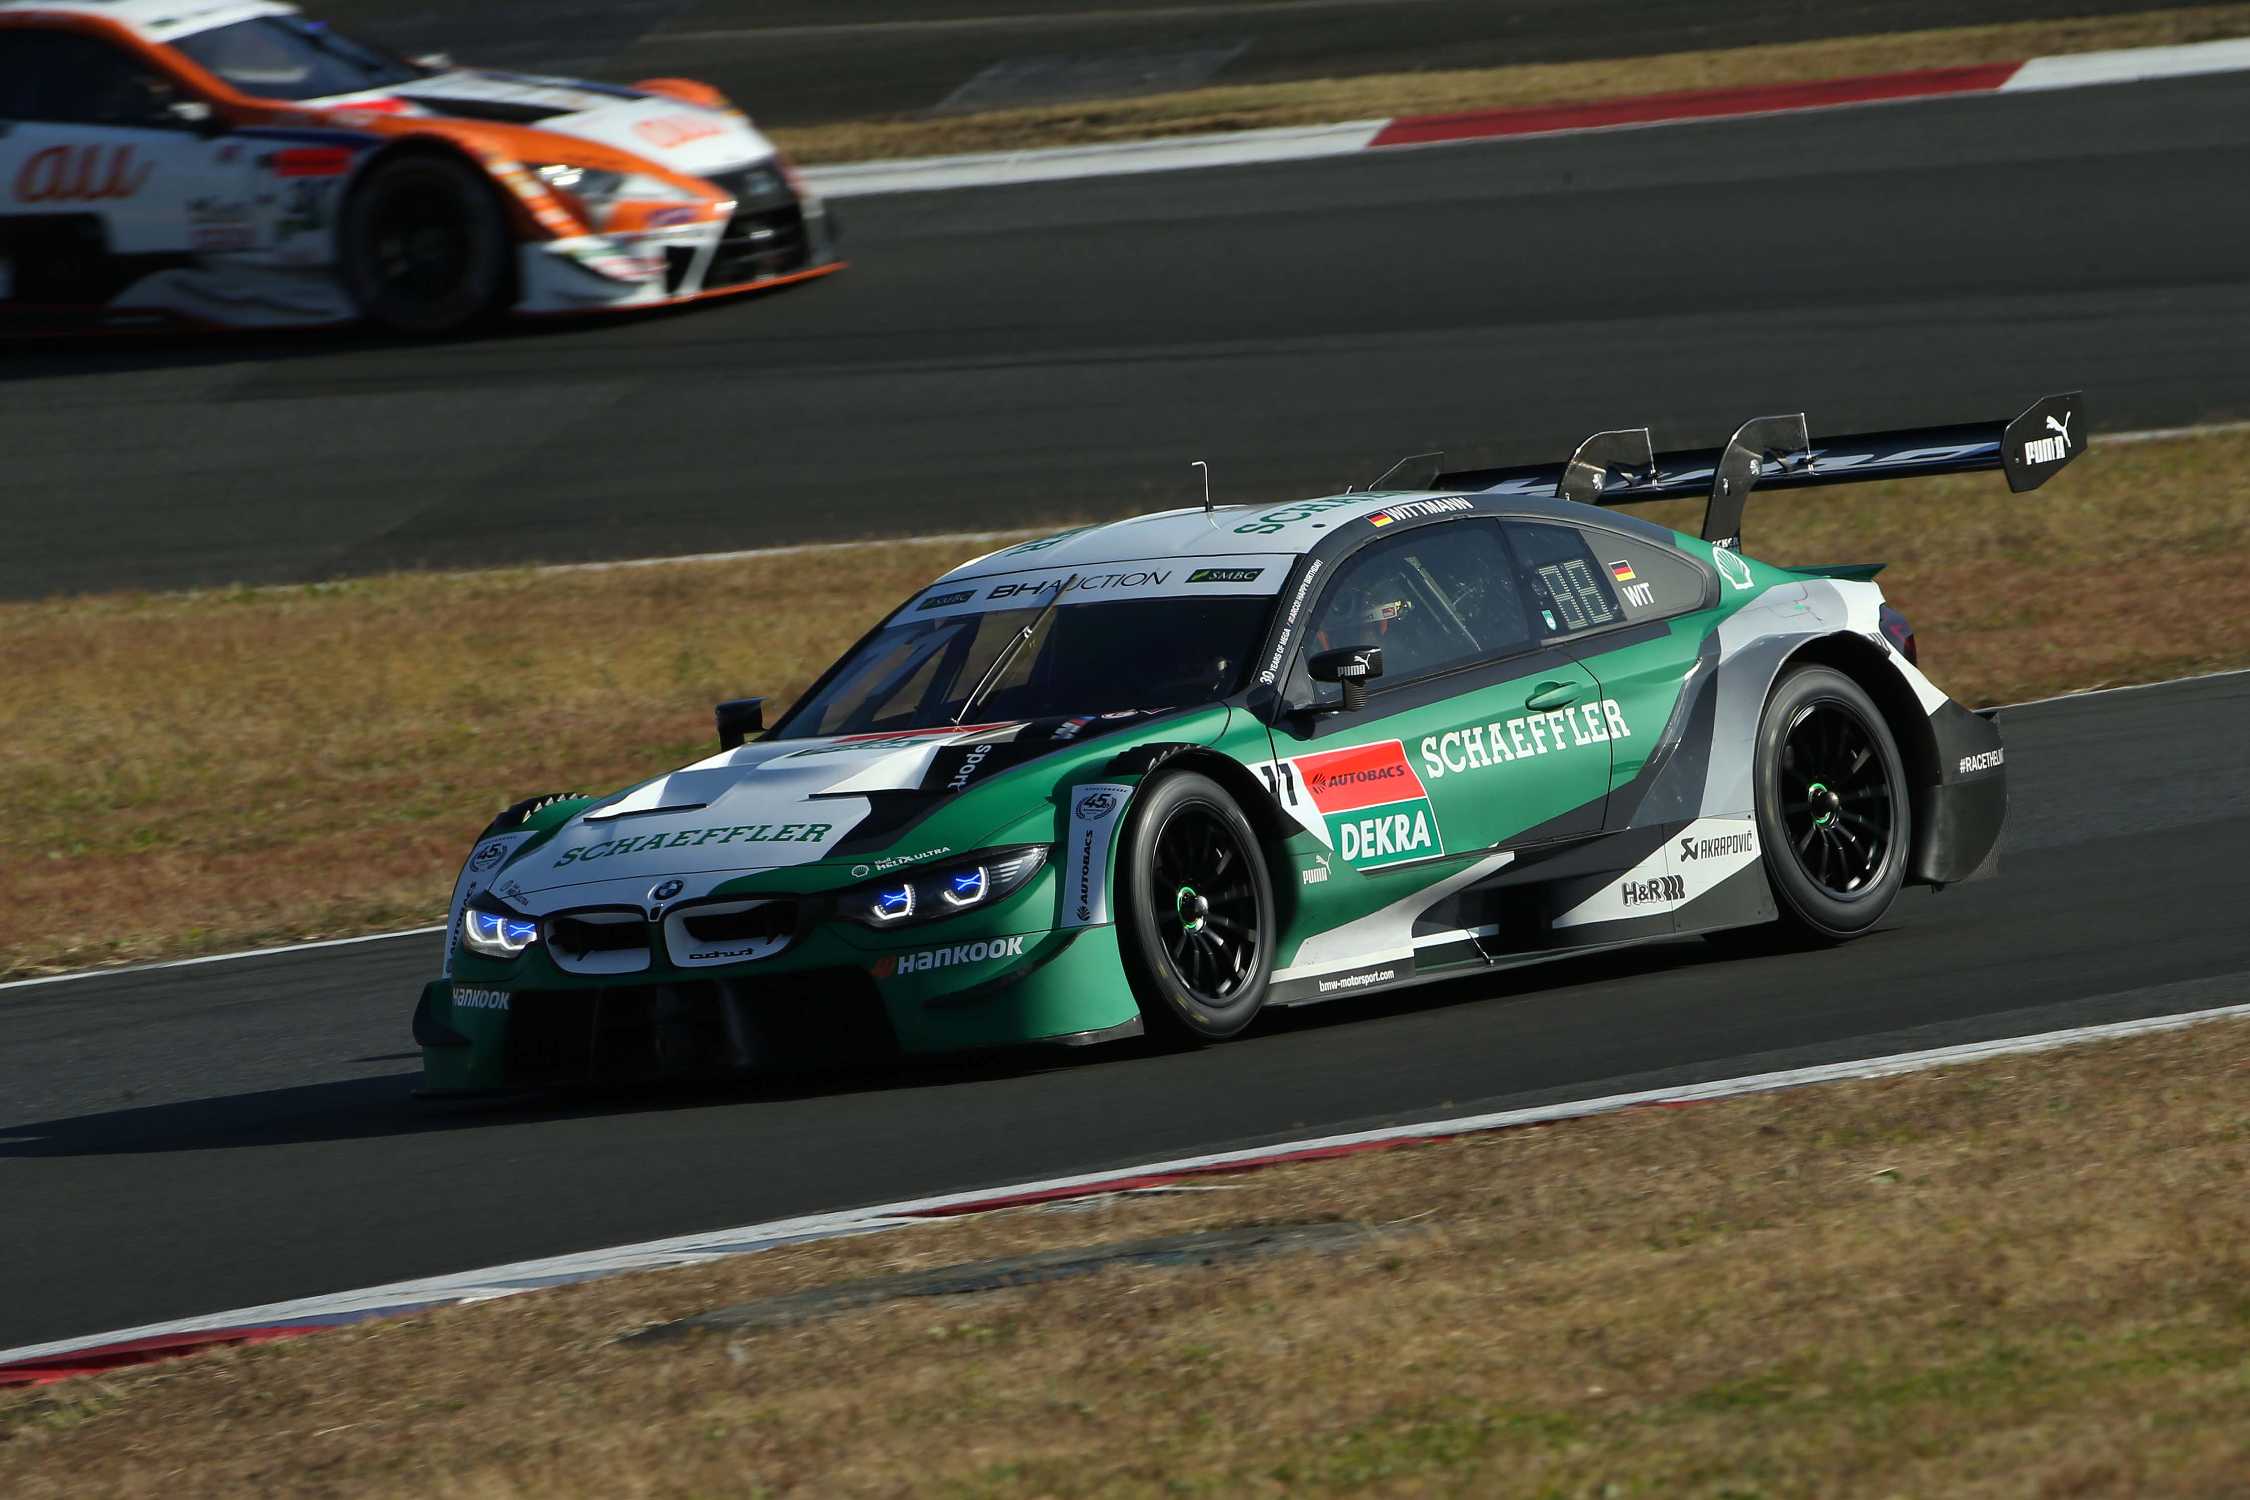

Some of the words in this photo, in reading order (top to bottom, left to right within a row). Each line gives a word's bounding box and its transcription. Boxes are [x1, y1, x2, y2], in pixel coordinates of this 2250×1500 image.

[12, 144, 156, 203] au
[2025, 435, 2065, 465] PUMA
[1383, 497, 1473, 520] WITTMANN
[1208, 570, 1258, 581] SMBC
[1622, 582, 1655, 607] WIT
[1259, 670, 1276, 686] 30
[1337, 664, 1366, 678] PUMA
[1420, 698, 1631, 779] SCHAEFFLER
[1327, 765, 1405, 789] AUTOBACS
[552, 823, 833, 868] SCHAEFFLER
[1340, 809, 1432, 861] DEKRA
[914, 846, 951, 860] ULTRA
[1081, 829, 1093, 904] AUTOBACS
[1302, 867, 1328, 885] PUMA
[1622, 879, 1662, 905] H&R
[1318, 969, 1395, 993] bmw-motorsport.com
